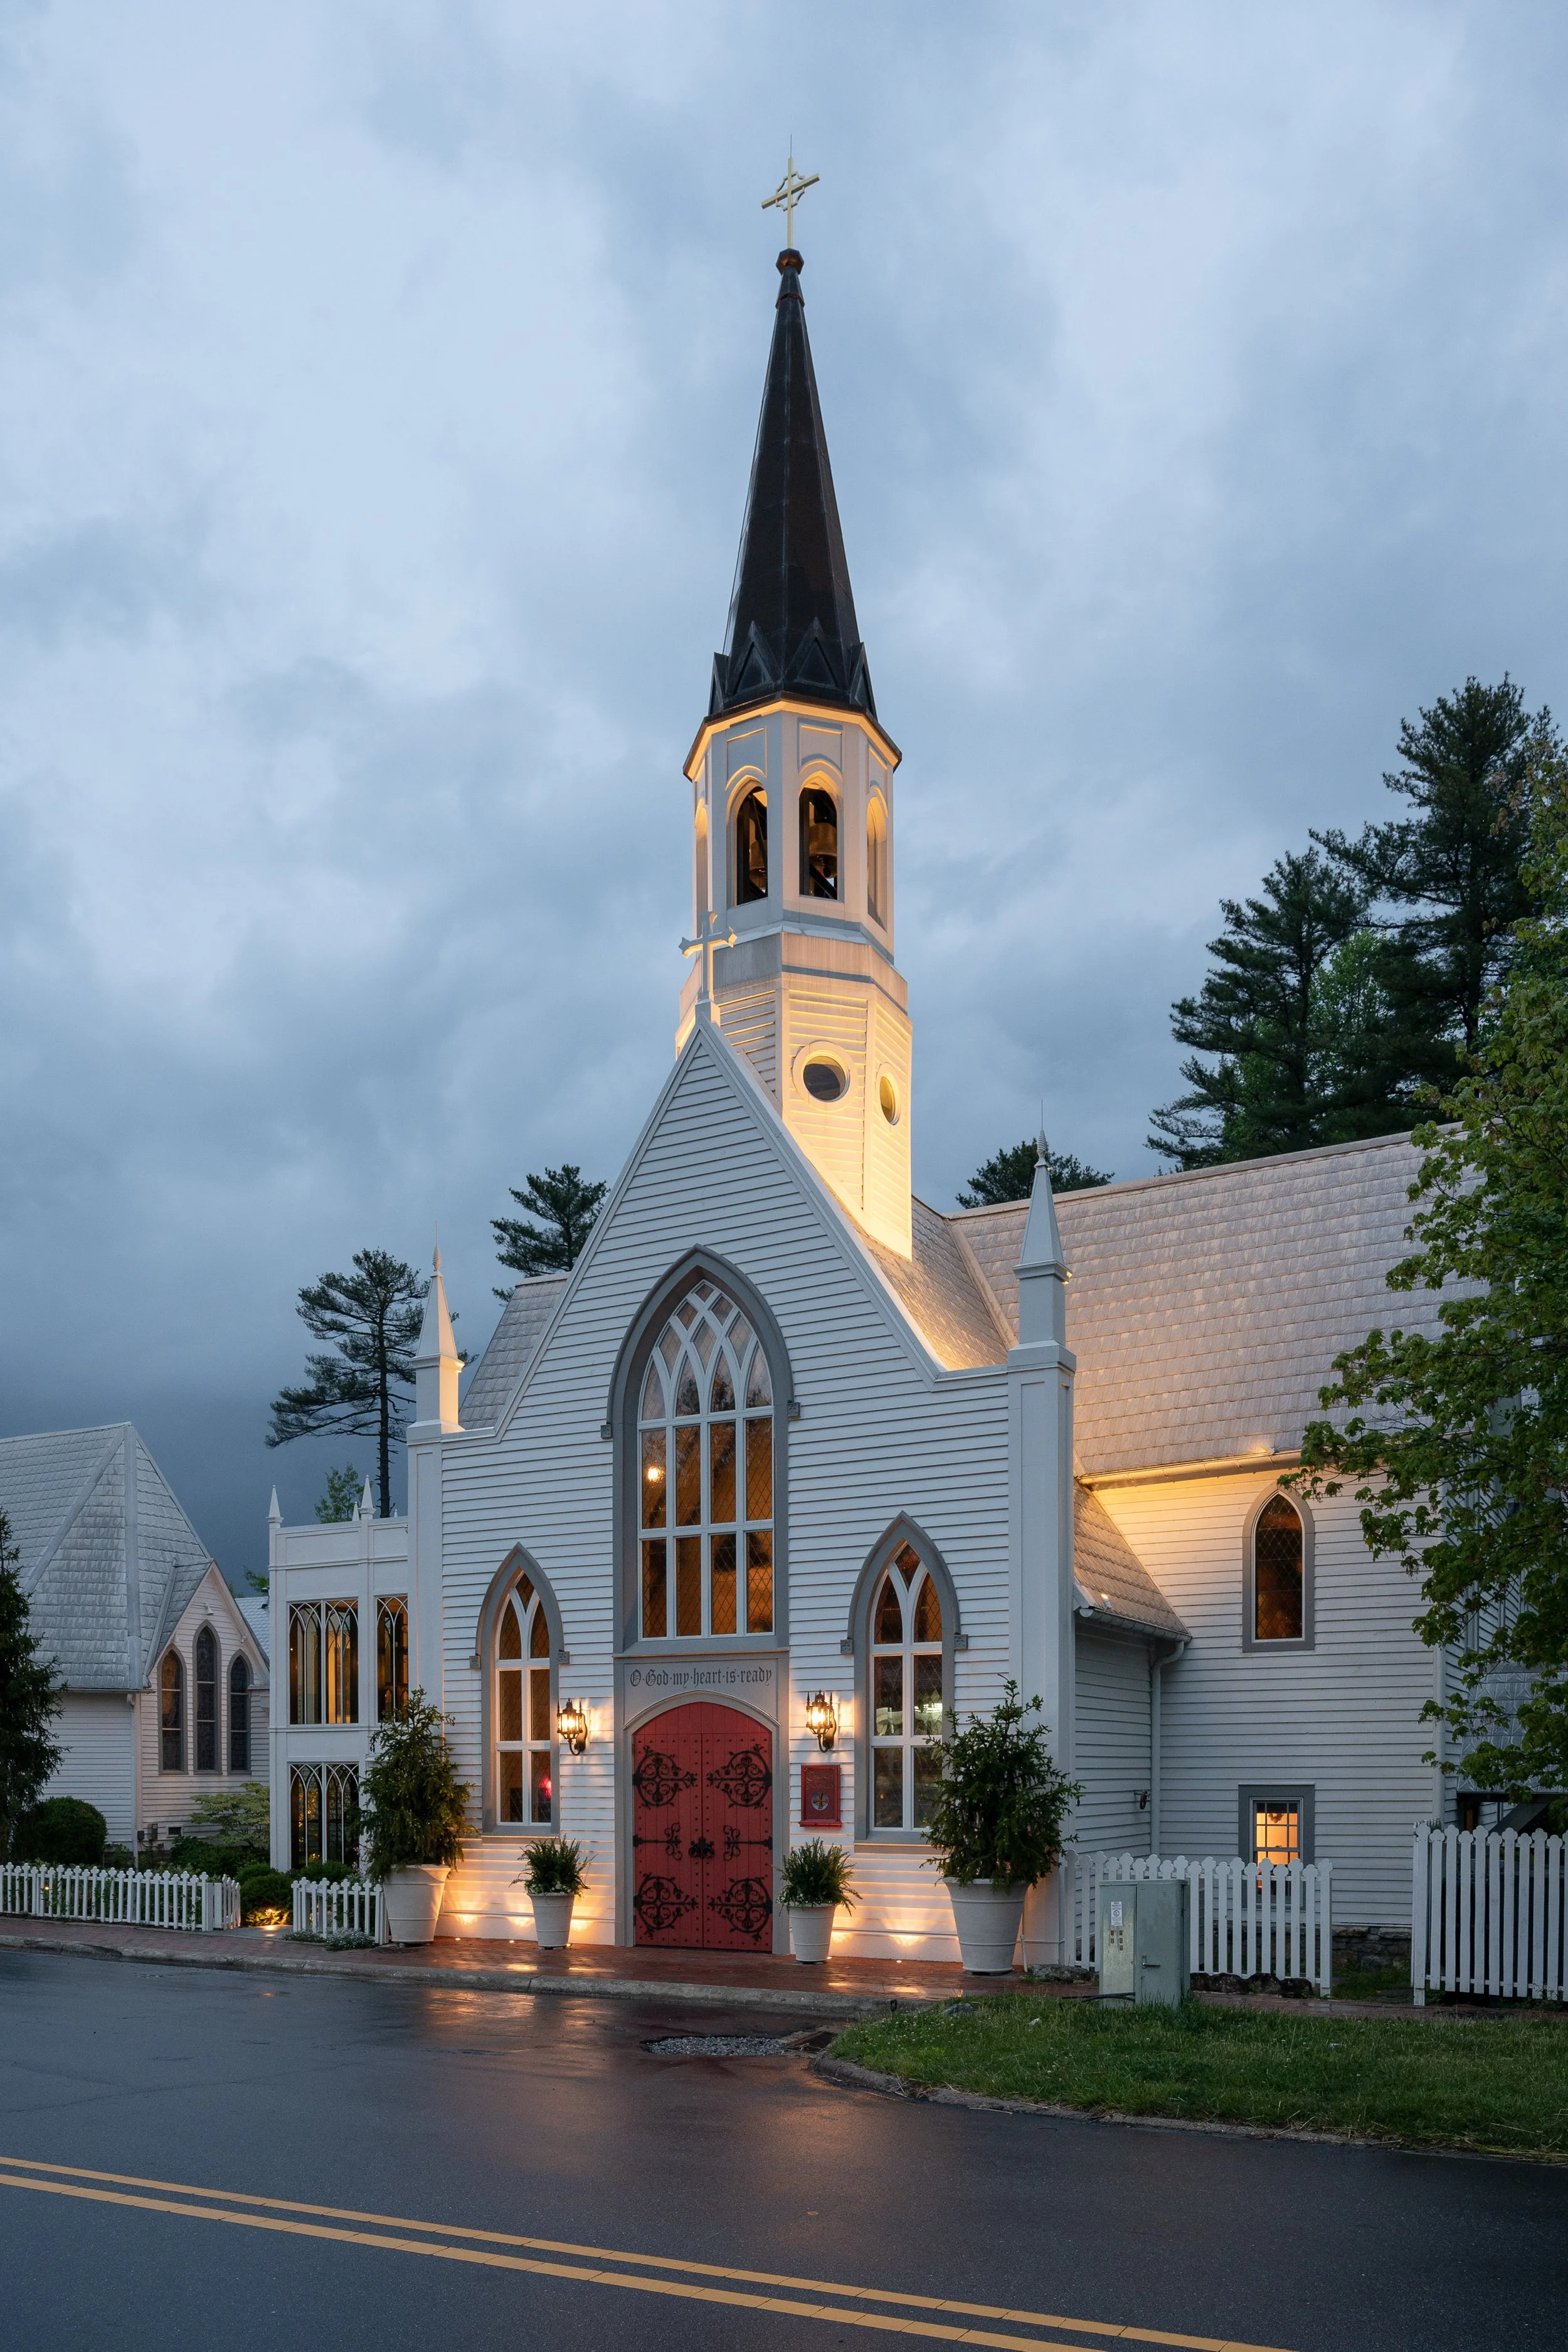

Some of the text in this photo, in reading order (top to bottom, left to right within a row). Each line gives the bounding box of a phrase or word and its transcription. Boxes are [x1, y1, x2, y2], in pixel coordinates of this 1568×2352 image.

[630, 1666, 772, 1688] O God my heart is ready
